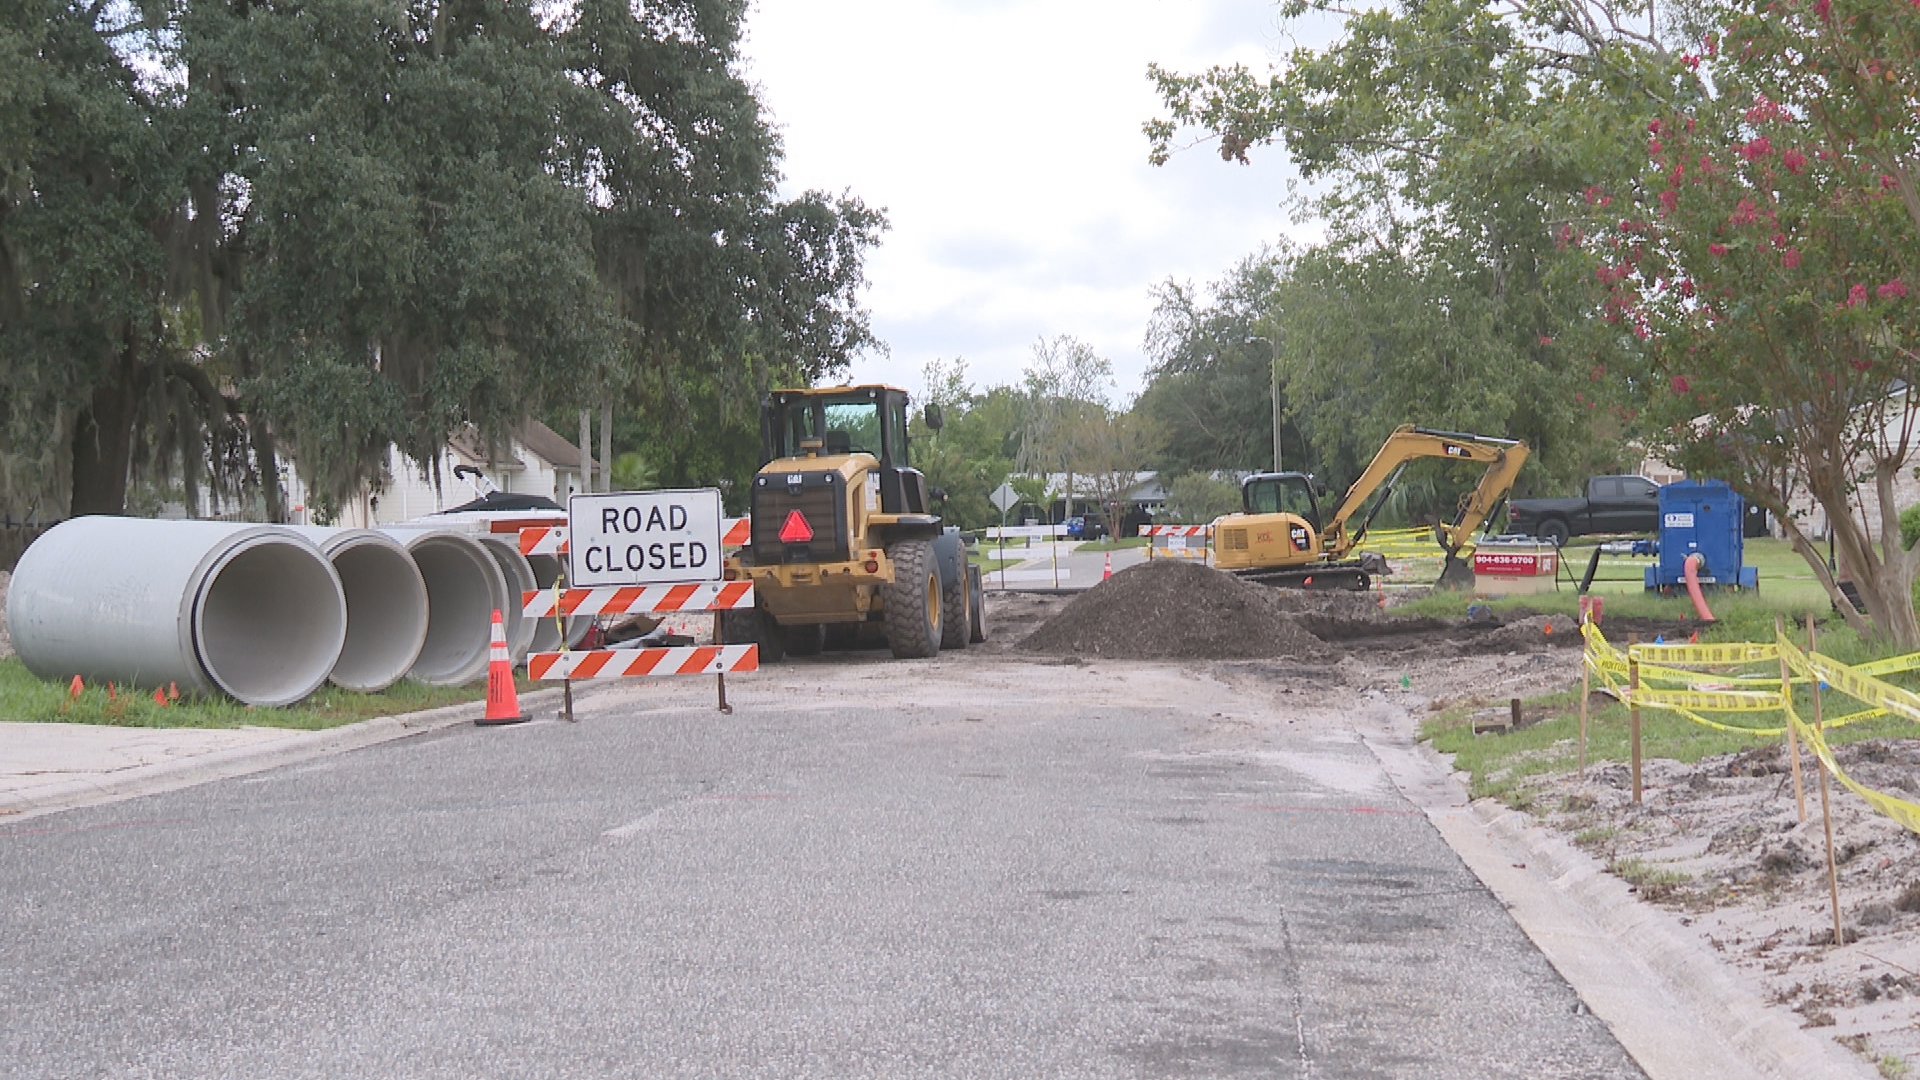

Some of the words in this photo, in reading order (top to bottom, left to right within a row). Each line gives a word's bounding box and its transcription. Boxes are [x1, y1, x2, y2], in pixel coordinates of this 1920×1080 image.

[602, 504, 688, 534] ROAD
[1291, 528, 1306, 539] CAT
[585, 541, 708, 573] CLOSED
